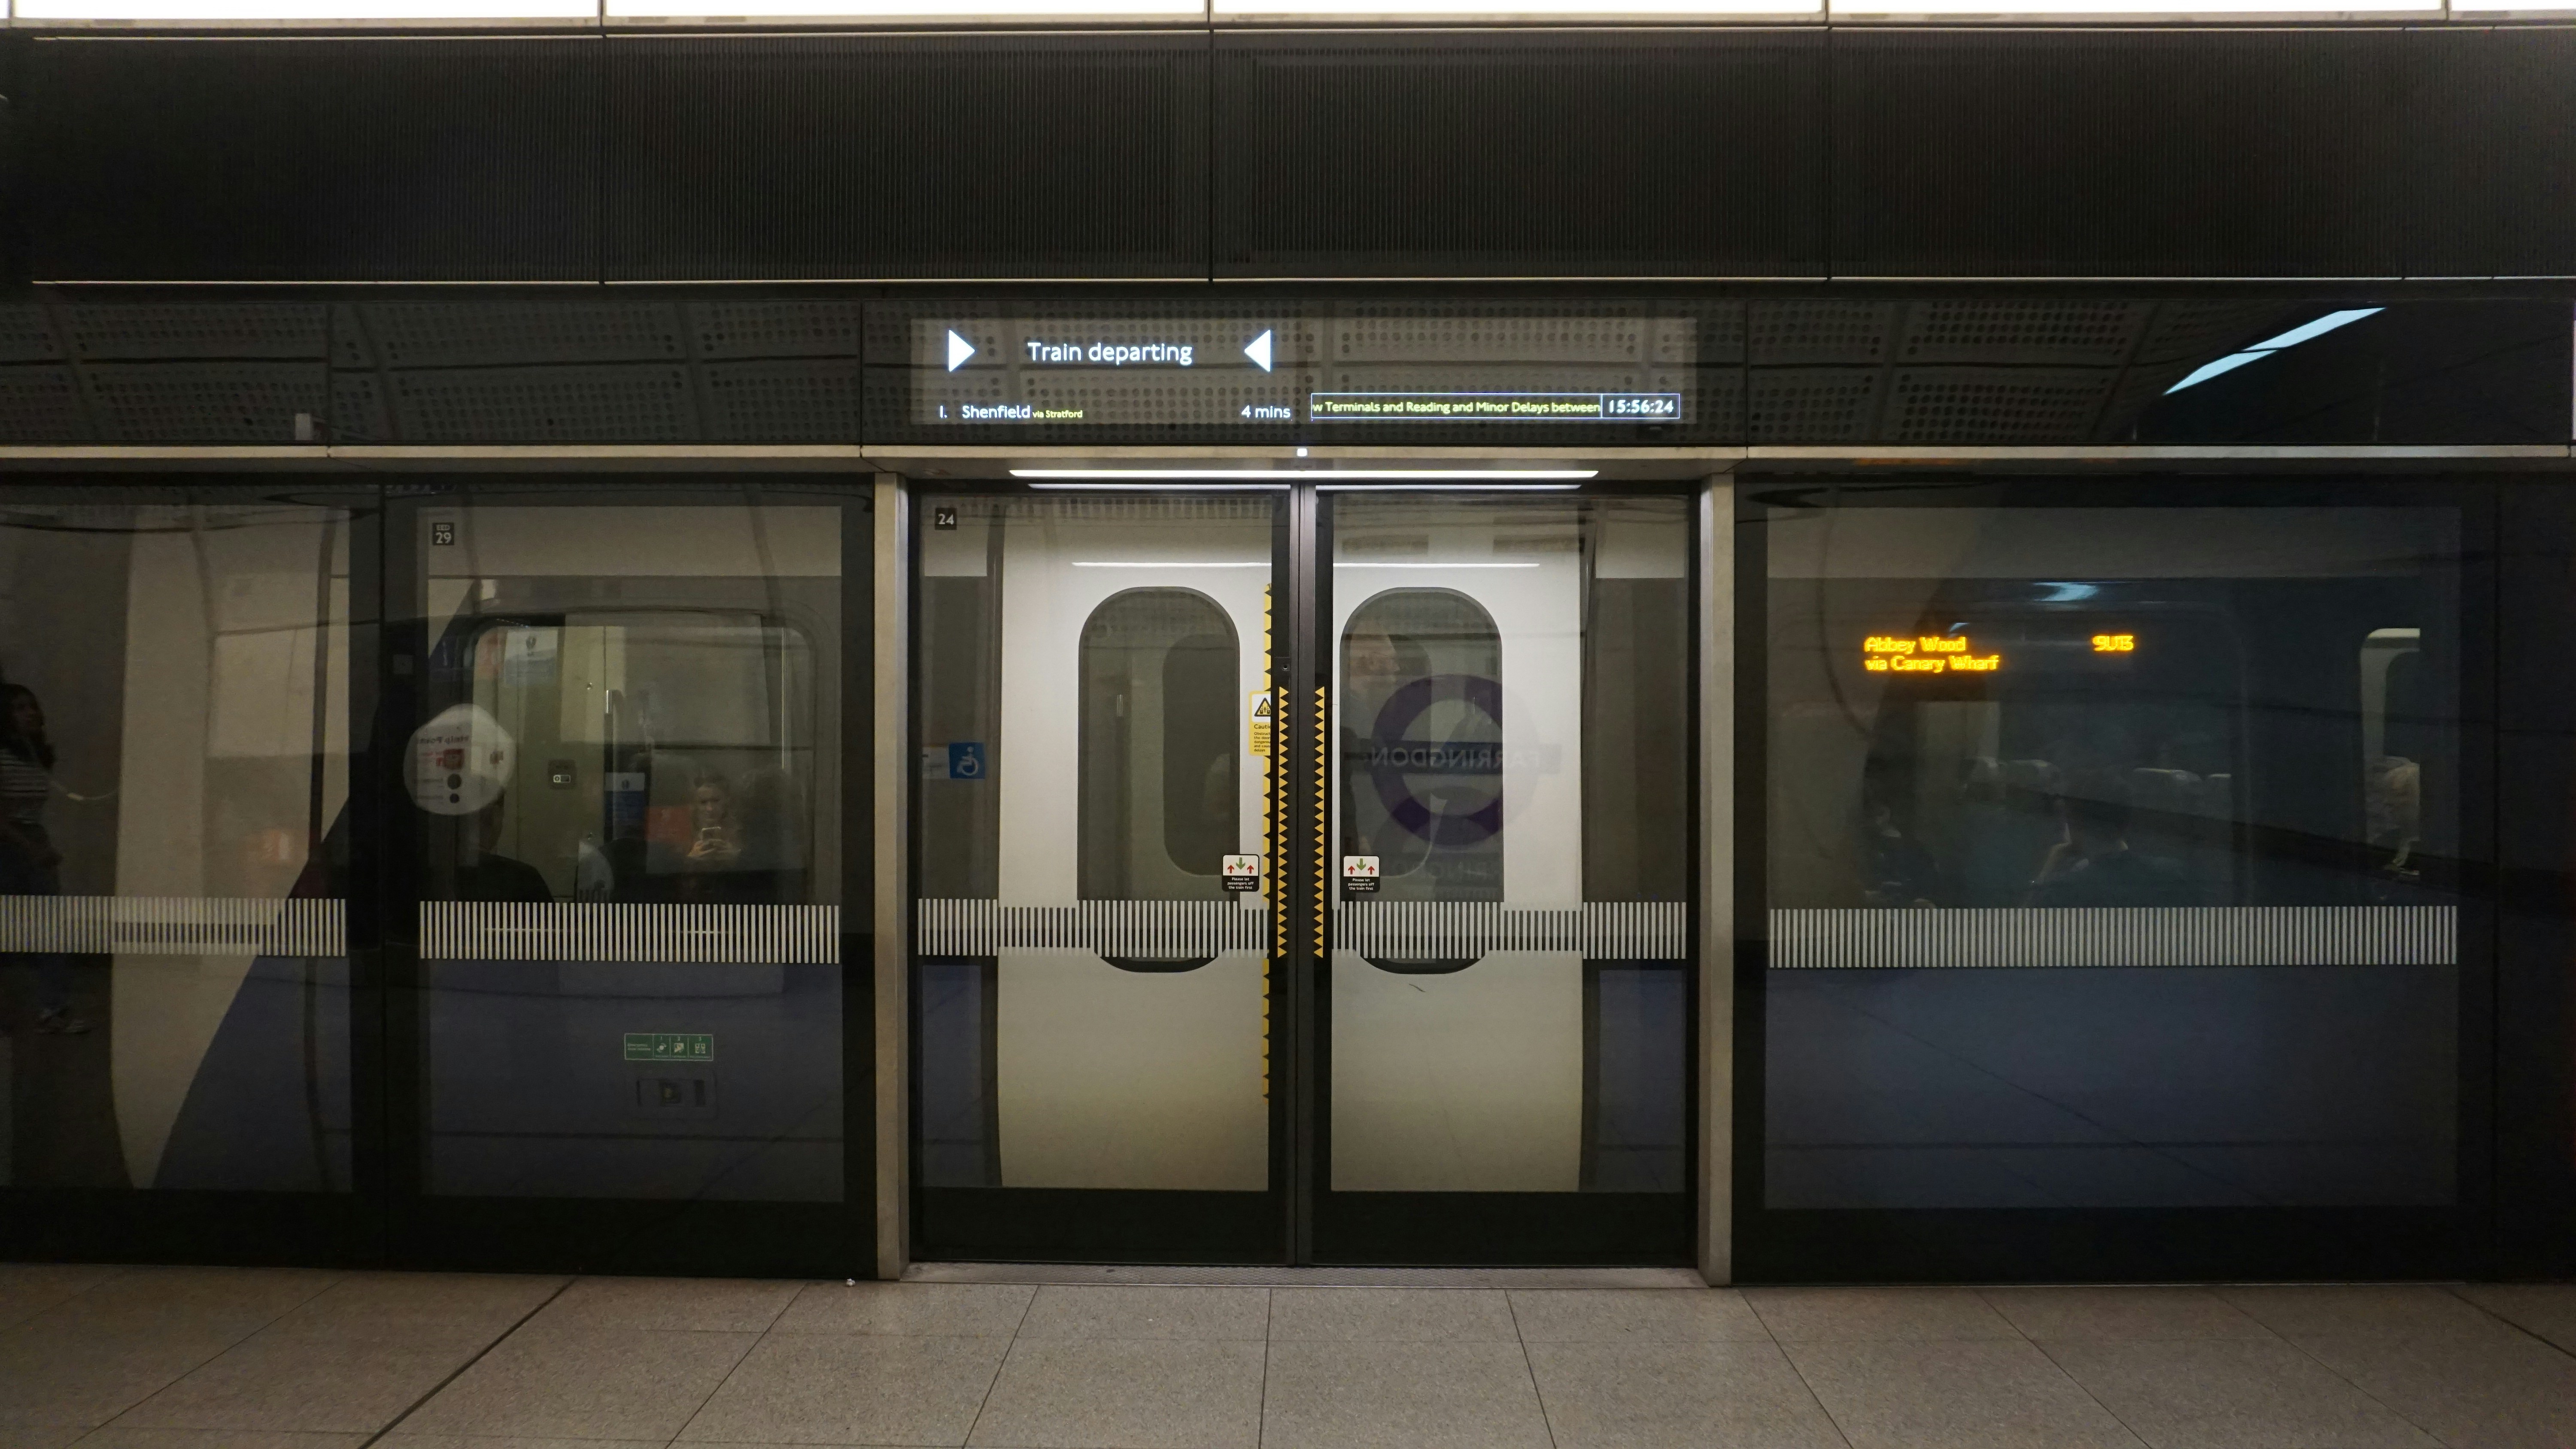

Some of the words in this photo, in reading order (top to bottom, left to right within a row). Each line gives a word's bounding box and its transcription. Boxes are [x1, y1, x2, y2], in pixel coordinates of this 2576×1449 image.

[1028, 342, 1082, 362] Train
[1088, 342, 1193, 366] departing
[962, 405, 1031, 418] Shenfield
[1032, 410, 1044, 418] via
[1045, 409, 1083, 419] Stratford
[1241, 405, 1251, 418] 4
[1255, 405, 1291, 418] mins
[1325, 402, 1381, 412] Terminals
[1382, 402, 1403, 412] and
[1406, 402, 1451, 414] Reading
[1452, 402, 1473, 412] and
[1476, 402, 1510, 412] Minor
[1512, 402, 1549, 414] Delays
[1552, 402, 1601, 412] between
[1609, 400, 1674, 414] 15:56:24
[938, 513, 954, 524] 24
[435, 532, 451, 543] 29
[1864, 637, 1916, 655] Abbey
[1919, 636, 1966, 652] Wood
[1865, 655, 1888, 671] via
[1890, 655, 1946, 673] Canary
[1948, 655, 1999, 671] Wharf
